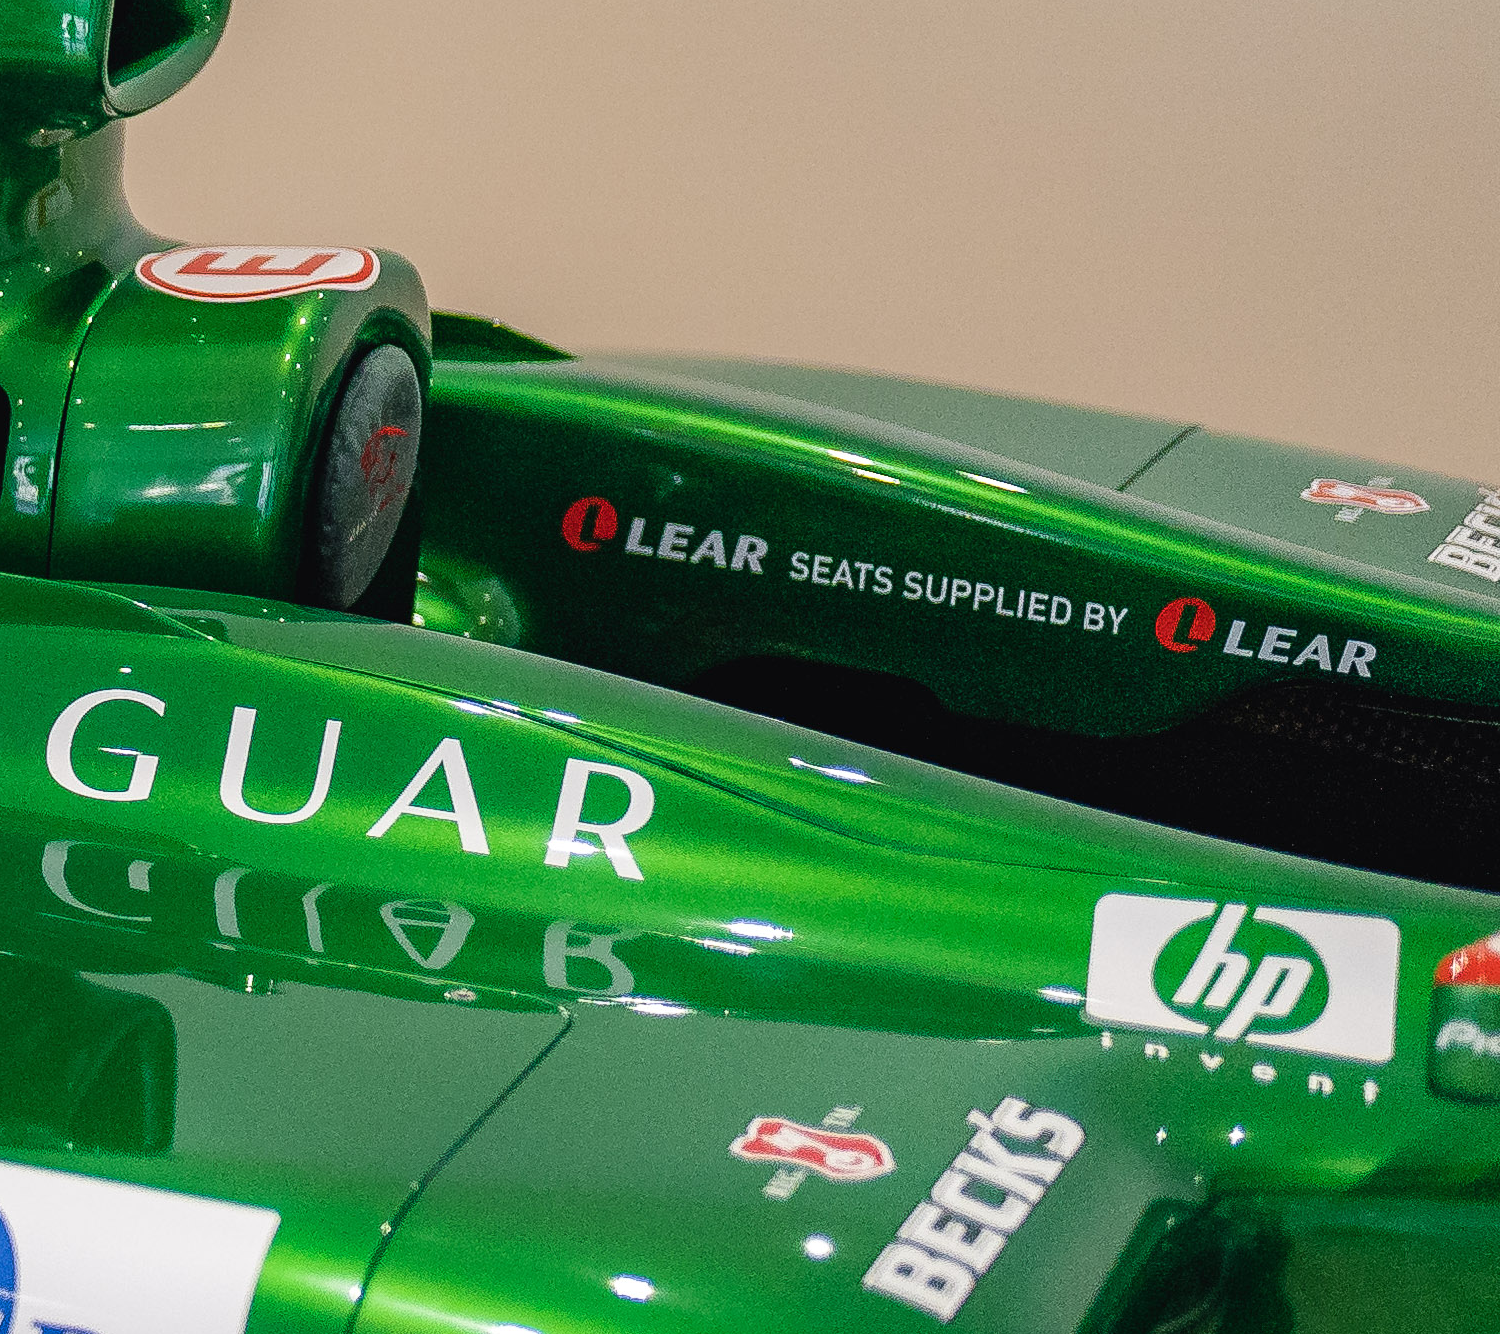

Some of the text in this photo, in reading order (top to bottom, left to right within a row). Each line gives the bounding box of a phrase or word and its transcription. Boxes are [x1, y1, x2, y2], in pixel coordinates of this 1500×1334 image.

[624, 515, 768, 574] LEAR
[788, 550, 894, 596] SEATS
[902, 570, 1072, 627] SUPPLIED
[1083, 599, 1129, 635] BY
[1222, 618, 1378, 679] LEAR
[1172, 902, 1313, 1043] hp
[1100, 1029, 1380, 1106] invent
[862, 1096, 1086, 1323] BECK'S
